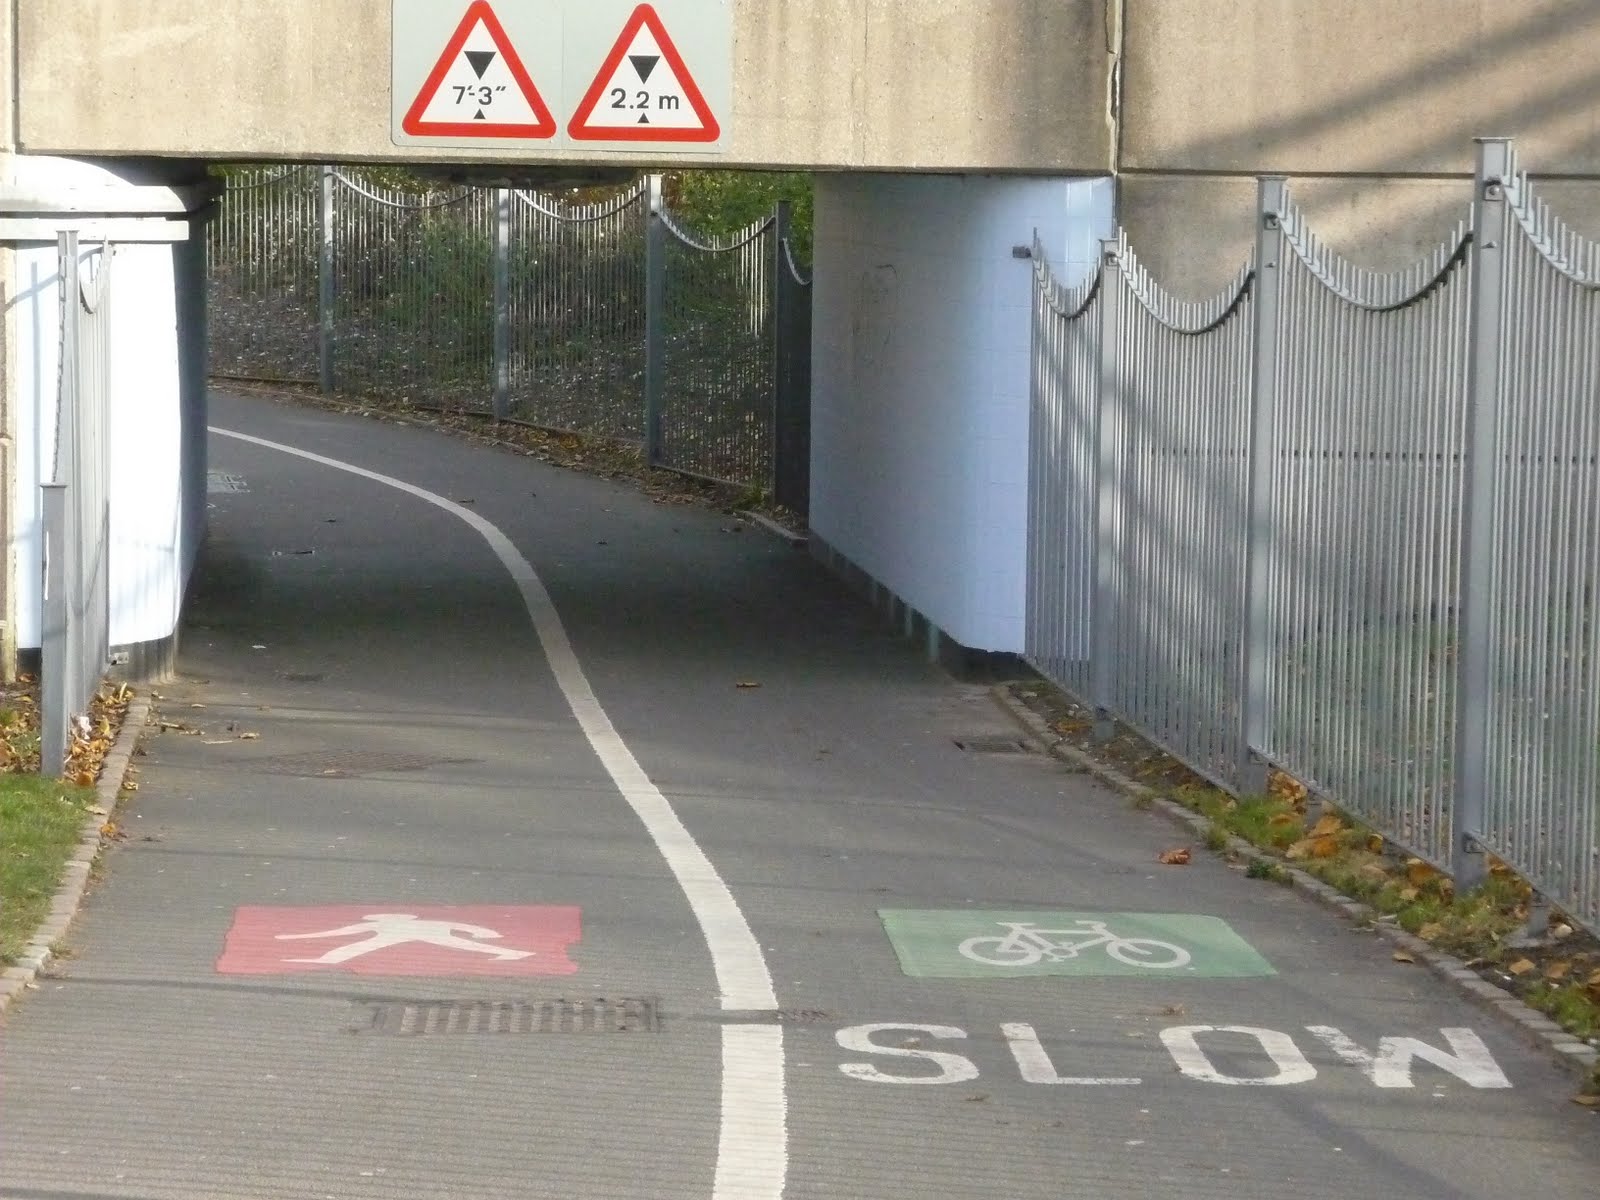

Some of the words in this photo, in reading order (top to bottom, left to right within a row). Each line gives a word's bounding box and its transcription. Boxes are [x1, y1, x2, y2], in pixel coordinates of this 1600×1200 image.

[611, 87, 650, 109] 2.2
[658, 95, 679, 110] m
[835, 1022, 1513, 1089] SLOW
